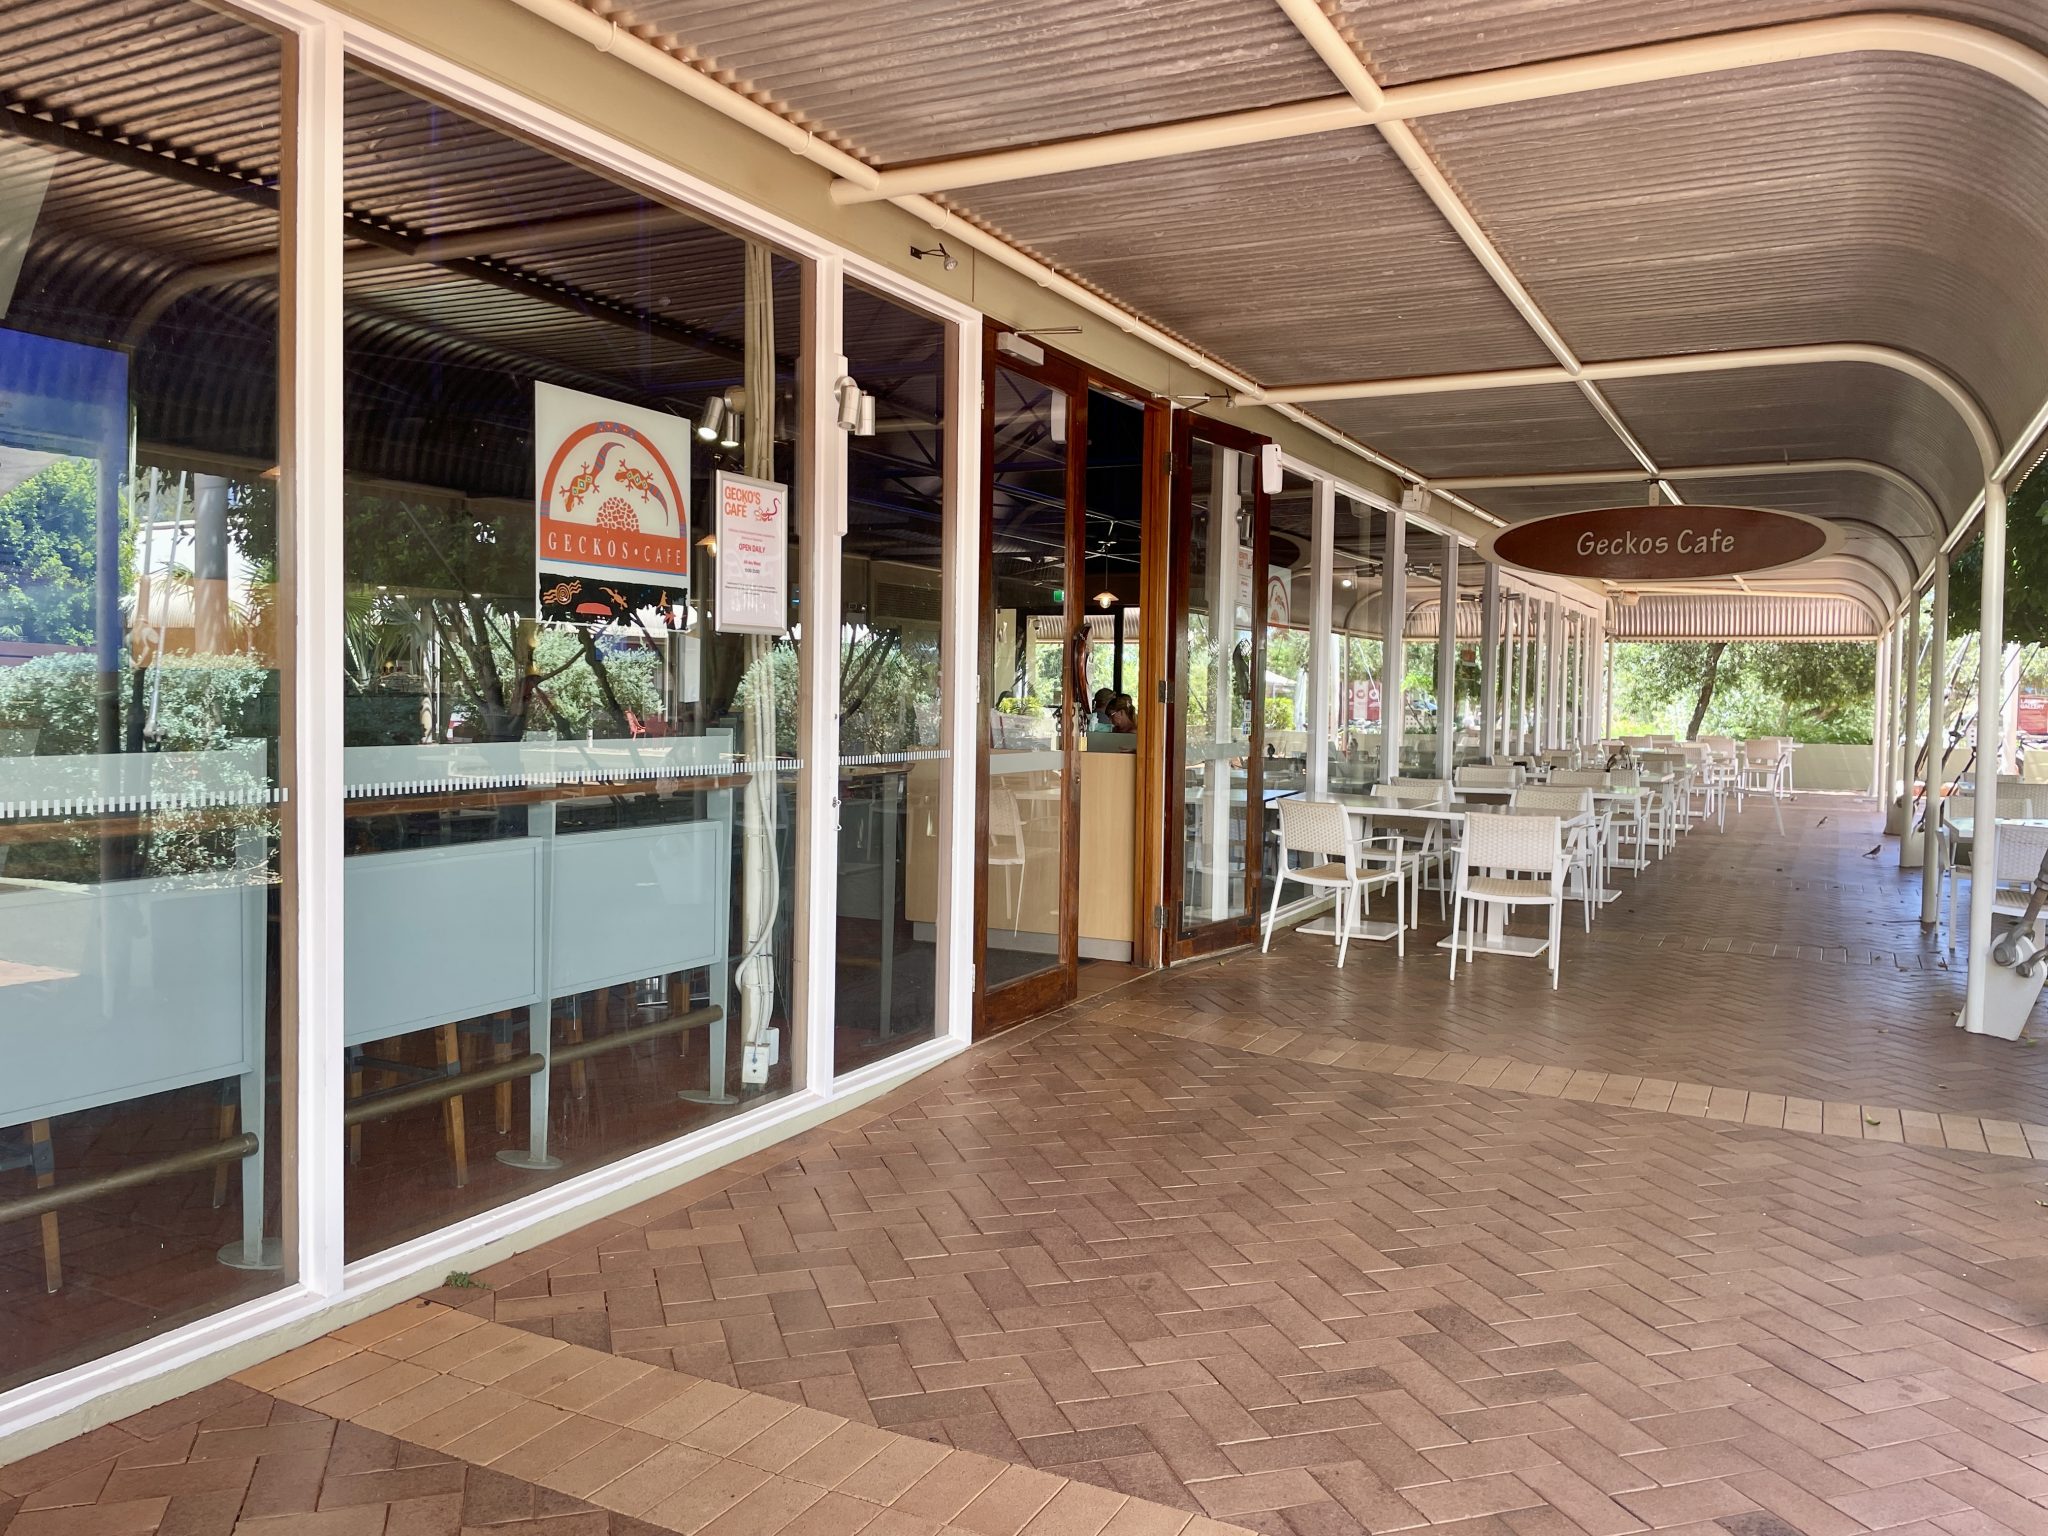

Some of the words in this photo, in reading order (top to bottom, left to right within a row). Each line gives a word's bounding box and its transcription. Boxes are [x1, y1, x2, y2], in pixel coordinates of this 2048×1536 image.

[725, 486, 761, 505] GECKO'S
[739, 543, 752, 552] OPEN
[752, 545, 766, 553] DAILY
[1576, 531, 1669, 555] Geckos
[1677, 528, 1735, 554] Cafe
